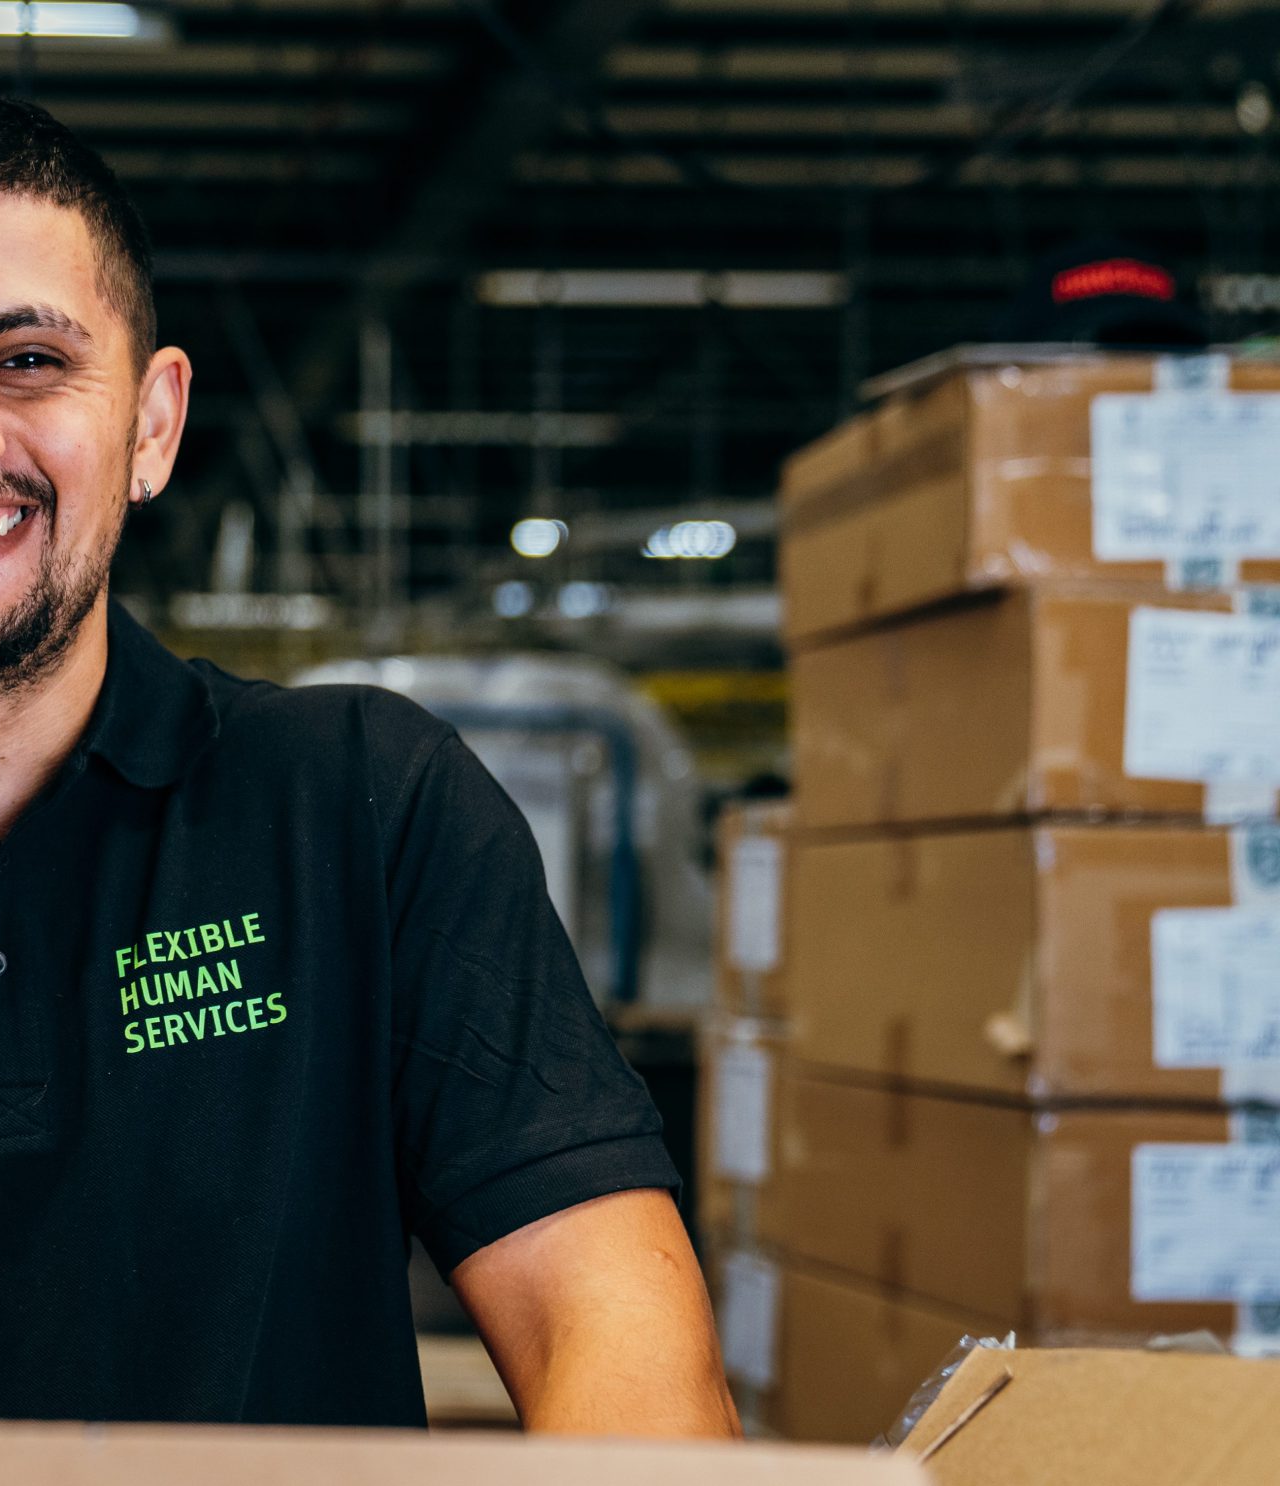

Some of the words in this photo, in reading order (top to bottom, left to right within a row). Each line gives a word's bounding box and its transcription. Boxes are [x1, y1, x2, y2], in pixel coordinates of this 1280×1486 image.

[115, 912, 266, 978] FLEXIBLE
[120, 959, 243, 1015] HUMAN
[124, 992, 287, 1054] SERVICES
